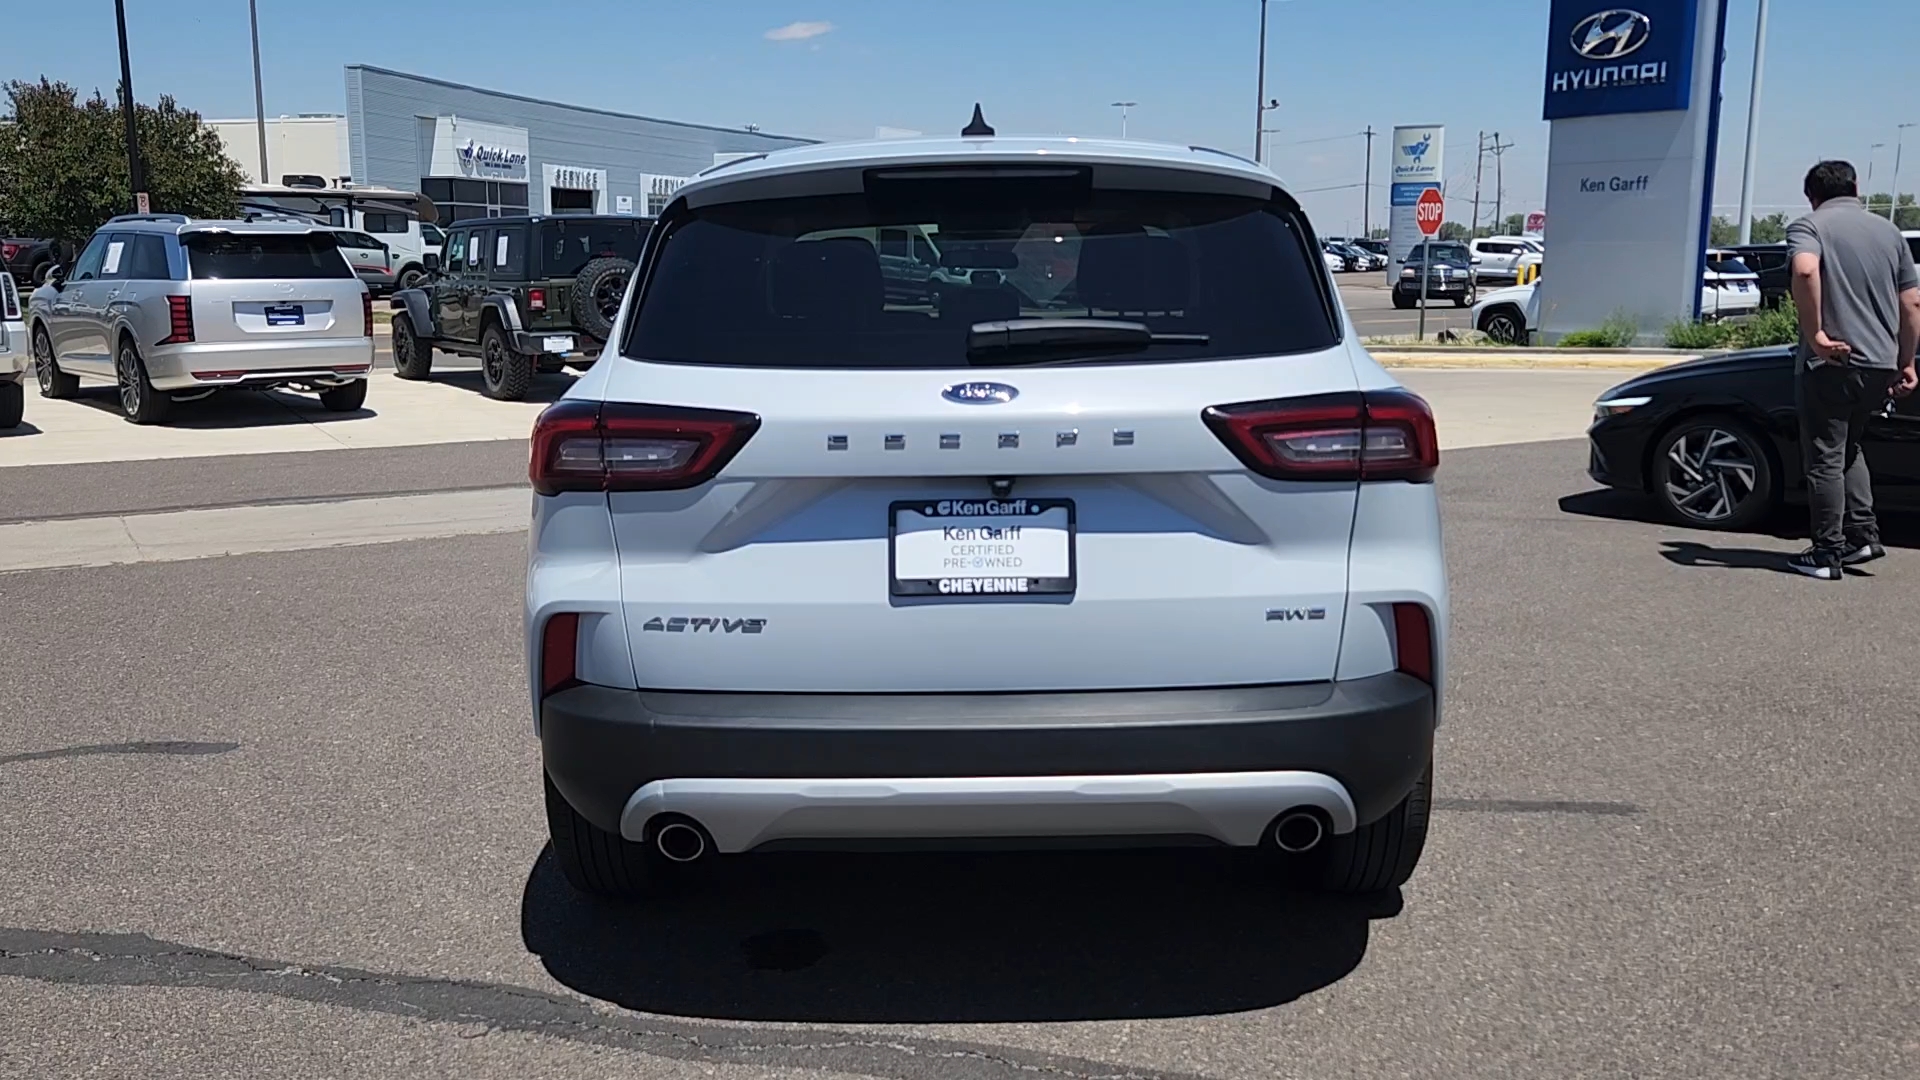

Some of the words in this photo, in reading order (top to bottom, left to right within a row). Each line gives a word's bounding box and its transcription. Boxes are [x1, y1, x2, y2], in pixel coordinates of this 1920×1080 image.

[1552, 61, 1667, 92] HYUNDAI
[476, 145, 503, 162] Quick
[504, 149, 527, 165] Lane
[555, 168, 598, 184] SERVICE
[1580, 178, 1605, 192] Ken
[1609, 175, 1649, 191] Garff
[1418, 202, 1441, 221] STOP
[953, 501, 984, 515] Ken
[986, 501, 1027, 515] Garff
[944, 526, 976, 541] Ken
[980, 526, 1021, 541] Garff
[951, 545, 1015, 556] CERTIFIED
[939, 578, 1028, 593] CHEYENNE
[643, 617, 767, 634] ACTIVE
